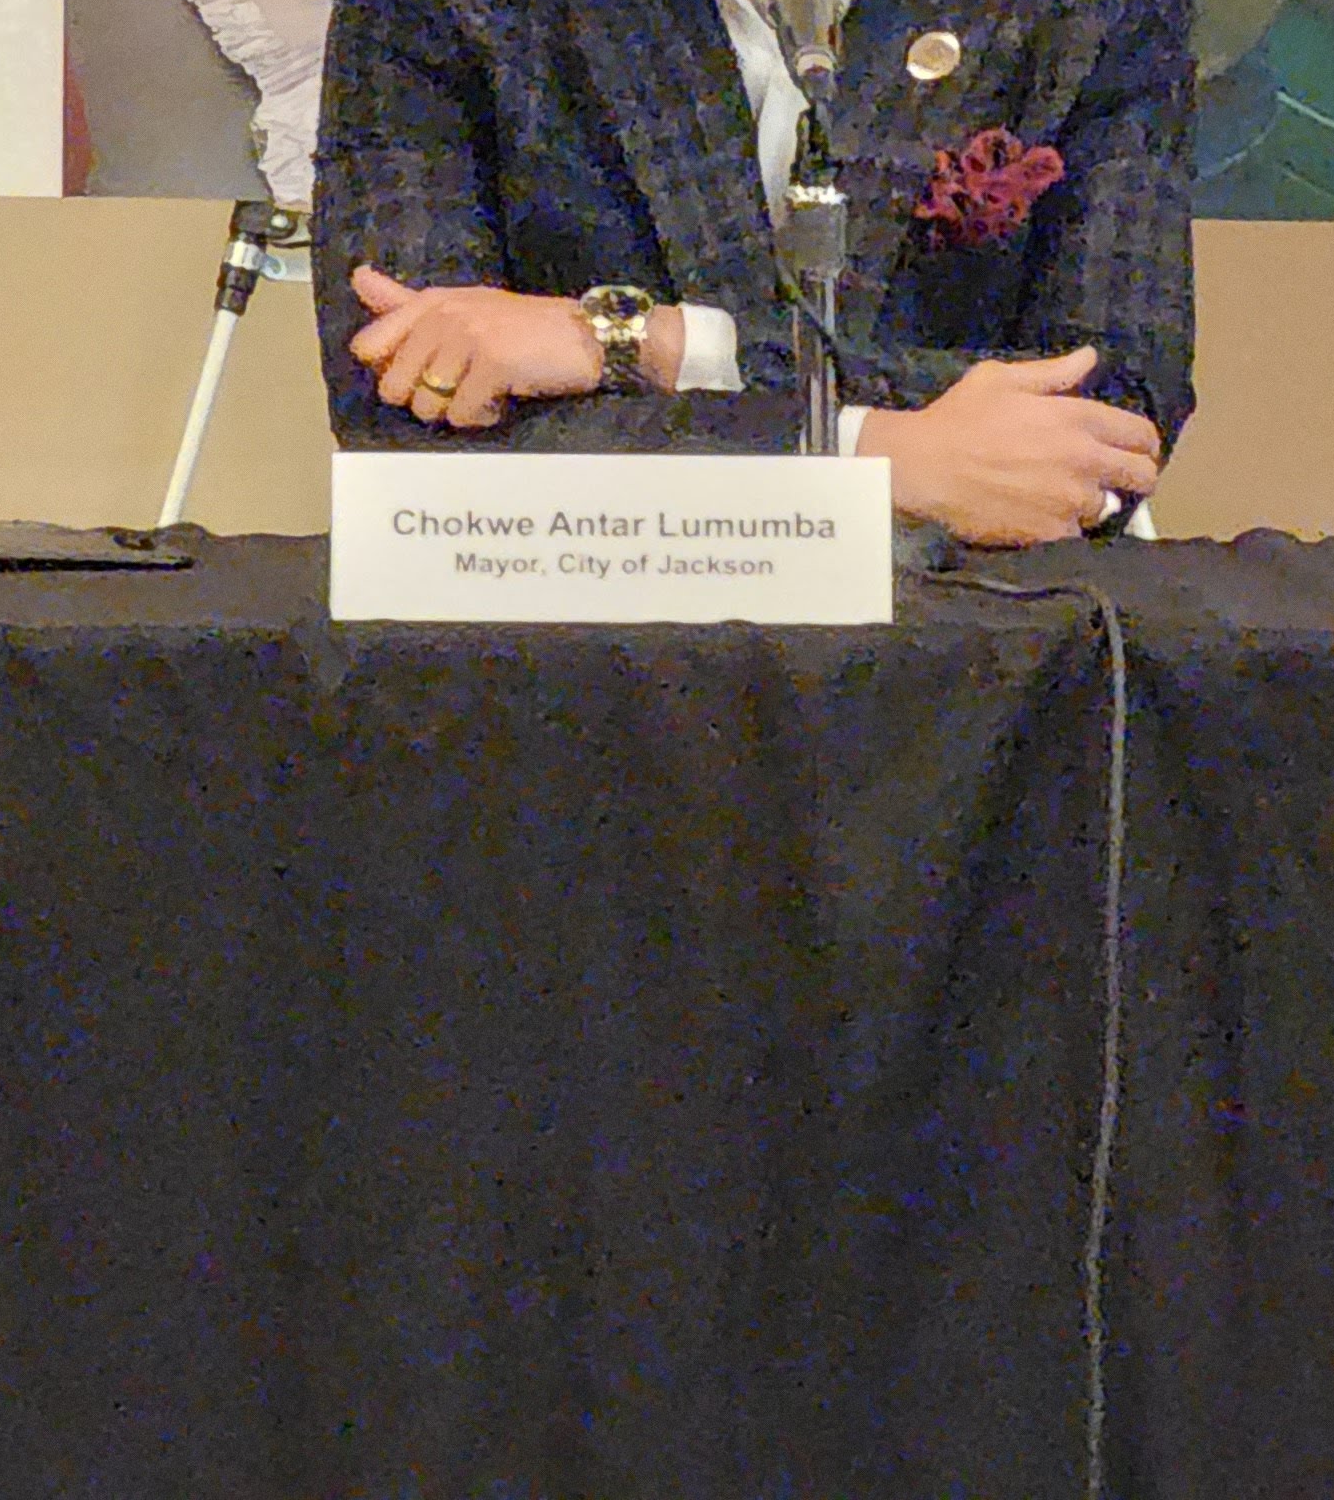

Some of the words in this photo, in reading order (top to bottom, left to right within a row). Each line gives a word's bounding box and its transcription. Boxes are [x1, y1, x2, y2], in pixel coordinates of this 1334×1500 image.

[392, 509, 535, 538] Chokwe
[547, 510, 646, 539] Antar
[658, 511, 836, 539] Lumumba
[454, 551, 547, 579] Mayor,
[557, 552, 612, 580] City
[621, 553, 650, 576] of
[656, 553, 775, 577] Jackson
